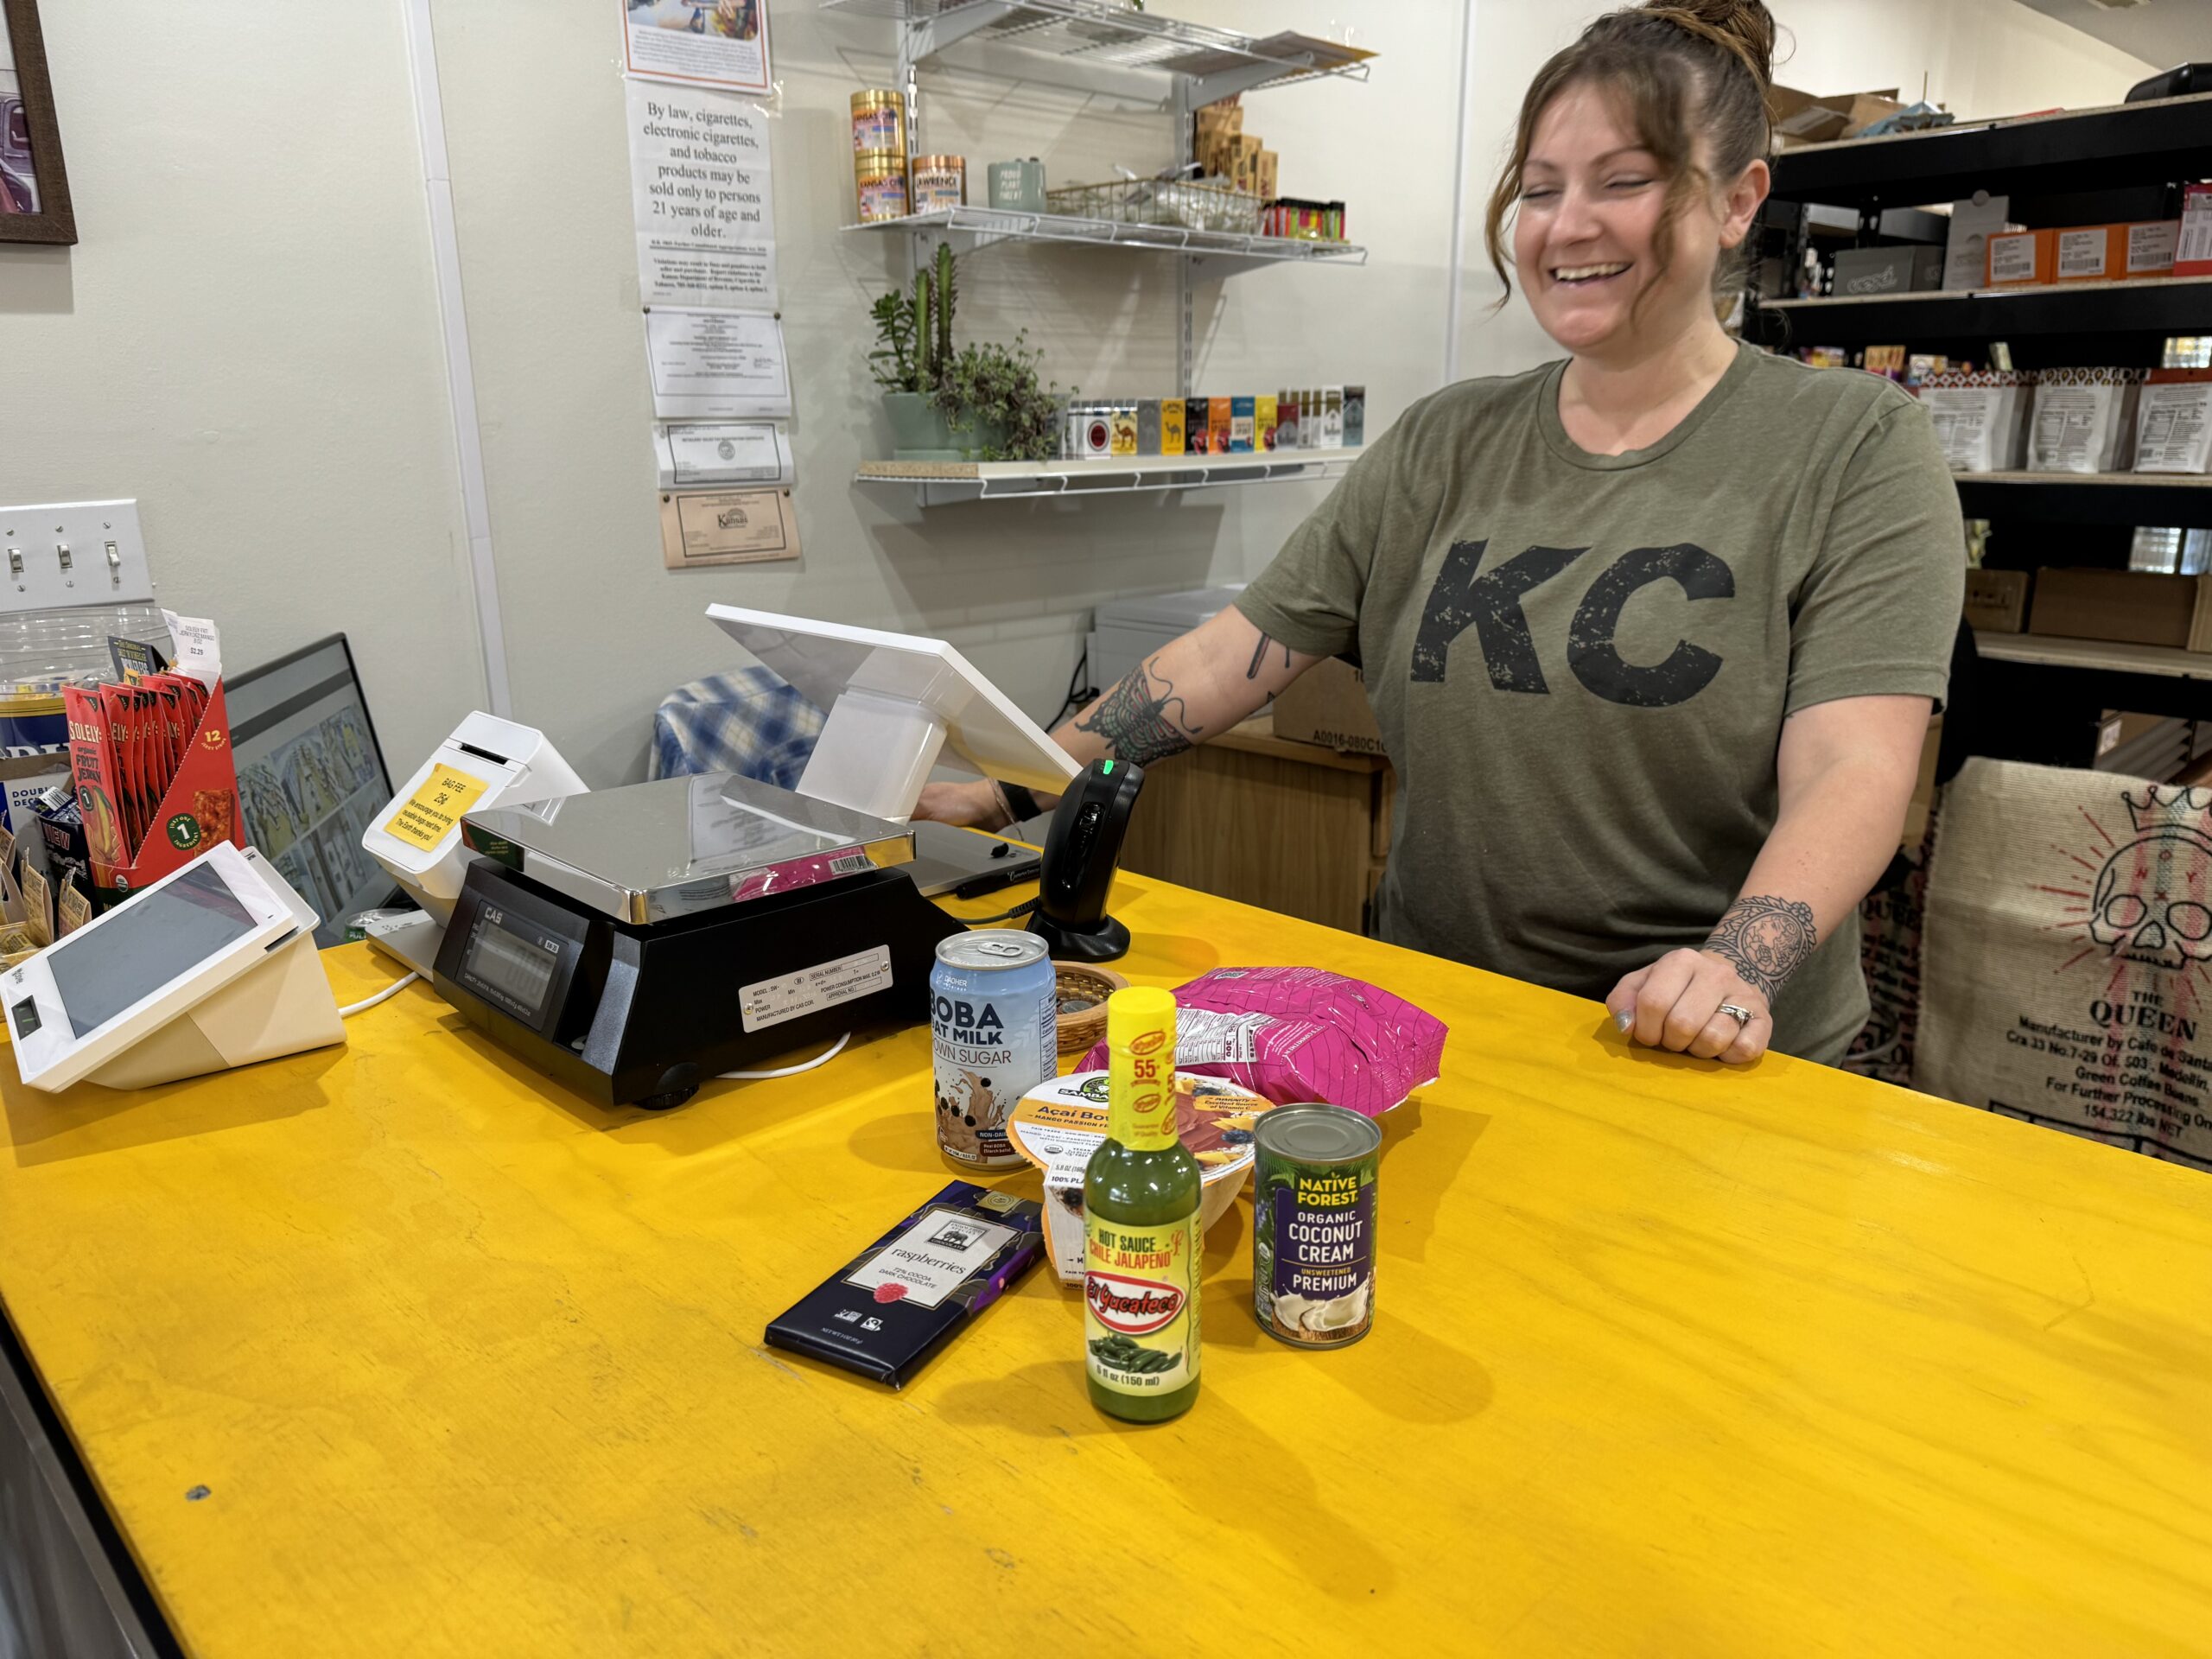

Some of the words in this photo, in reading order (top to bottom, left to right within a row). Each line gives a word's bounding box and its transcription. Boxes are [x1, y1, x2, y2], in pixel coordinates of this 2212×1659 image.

[648, 102, 664, 119] By
[668, 105, 693, 122] law,
[696, 109, 753, 130] cigarettes,
[643, 123, 700, 141] electronic
[702, 130, 759, 149] cigarettes,
[670, 145, 690, 159] and
[694, 148, 737, 164] tobacco
[658, 164, 708, 181] products
[709, 171, 734, 186] may
[737, 169, 750, 184] be
[649, 182, 674, 196] sold
[677, 184, 702, 202] only
[705, 188, 716, 200] to
[719, 191, 761, 204] persons
[652, 200, 666, 214] 21
[671, 206, 701, 219] years
[703, 206, 716, 219] of
[718, 210, 738, 224] age
[741, 209, 760, 222] and
[691, 223, 727, 238] older.
[1410, 537, 1736, 708] KC
[190, 647, 204, 656] $2.29
[205, 730, 221, 742] 12
[76, 754, 99, 769] FRUIT
[78, 767, 102, 785] JERKY
[442, 778, 455, 790] BAG
[452, 782, 467, 793] FEE
[12, 786, 48, 798] DOUB
[414, 802, 433, 816] encourage
[44, 823, 71, 851] NEW
[176, 823, 191, 840] 1
[484, 906, 503, 925] CAS
[810, 969, 824, 980] SERIAL
[824, 966, 842, 977] NUMBER
[753, 988, 767, 997] MODEL
[755, 1005, 771, 1014] POWER
[821, 984, 836, 994] POWER
[836, 977, 862, 990] CONSUMPTION
[828, 989, 847, 1001] APPROVAL
[2134, 991, 2164, 1007] THE
[756, 1006, 790, 1022] MANUFACTURED
[2089, 1000, 2197, 1042] QUEEN
[953, 1027, 1003, 1045] MILK
[2019, 1015, 2103, 1047] Manufacturer
[2107, 1037, 2125, 1052] by
[933, 1037, 956, 1061] OWN
[959, 1048, 1012, 1065] SUGAR
[2005, 1029, 2027, 1046] Cra
[2125, 1056, 2147, 1070] 503
[1134, 1058, 1156, 1078] 55
[1058, 1089, 1109, 1099] SAMBA
[2075, 1065, 2114, 1085] Green
[2120, 1072, 2160, 1092] Coffee
[2164, 1081, 2199, 1107] Beans
[2046, 1077, 2067, 1093] For
[2071, 1082, 2120, 1103] Further
[2123, 1090, 2191, 1122] Processing
[1034, 1115, 1063, 1123] MANGO
[1064, 1118, 1097, 1127] PASSION
[1080, 1111, 1109, 1122] Bo
[2084, 1103, 2134, 1123] 154.322
[2137, 1111, 2156, 1128] lbs
[2159, 1120, 2184, 1139] NET
[1299, 1176, 1357, 1192] NATIVE
[1297, 1191, 1357, 1206] FOREST
[1297, 1210, 1357, 1224] ORGANIC
[1098, 1228, 1116, 1249] HOT
[1120, 1236, 1156, 1253] SAUCE
[1288, 1220, 1363, 1244] COCONUT
[1089, 1237, 1111, 1264] CHILE
[1298, 1243, 1354, 1263] CREAM
[891, 1248, 967, 1275] raspberries
[879, 1268, 897, 1277] DARK
[897, 1274, 938, 1288] CHOCOLATE
[908, 1271, 931, 1281] COCOA
[1301, 1268, 1351, 1277] UNSWEETENED
[1293, 1273, 1357, 1293] PREMIUM
[1098, 1282, 1179, 1319] Yucateco
[1103, 1365, 1109, 1378] fl
[1110, 1371, 1120, 1382] oz
[1121, 1371, 1143, 1386] (150
[1144, 1376, 1160, 1388] ml)
